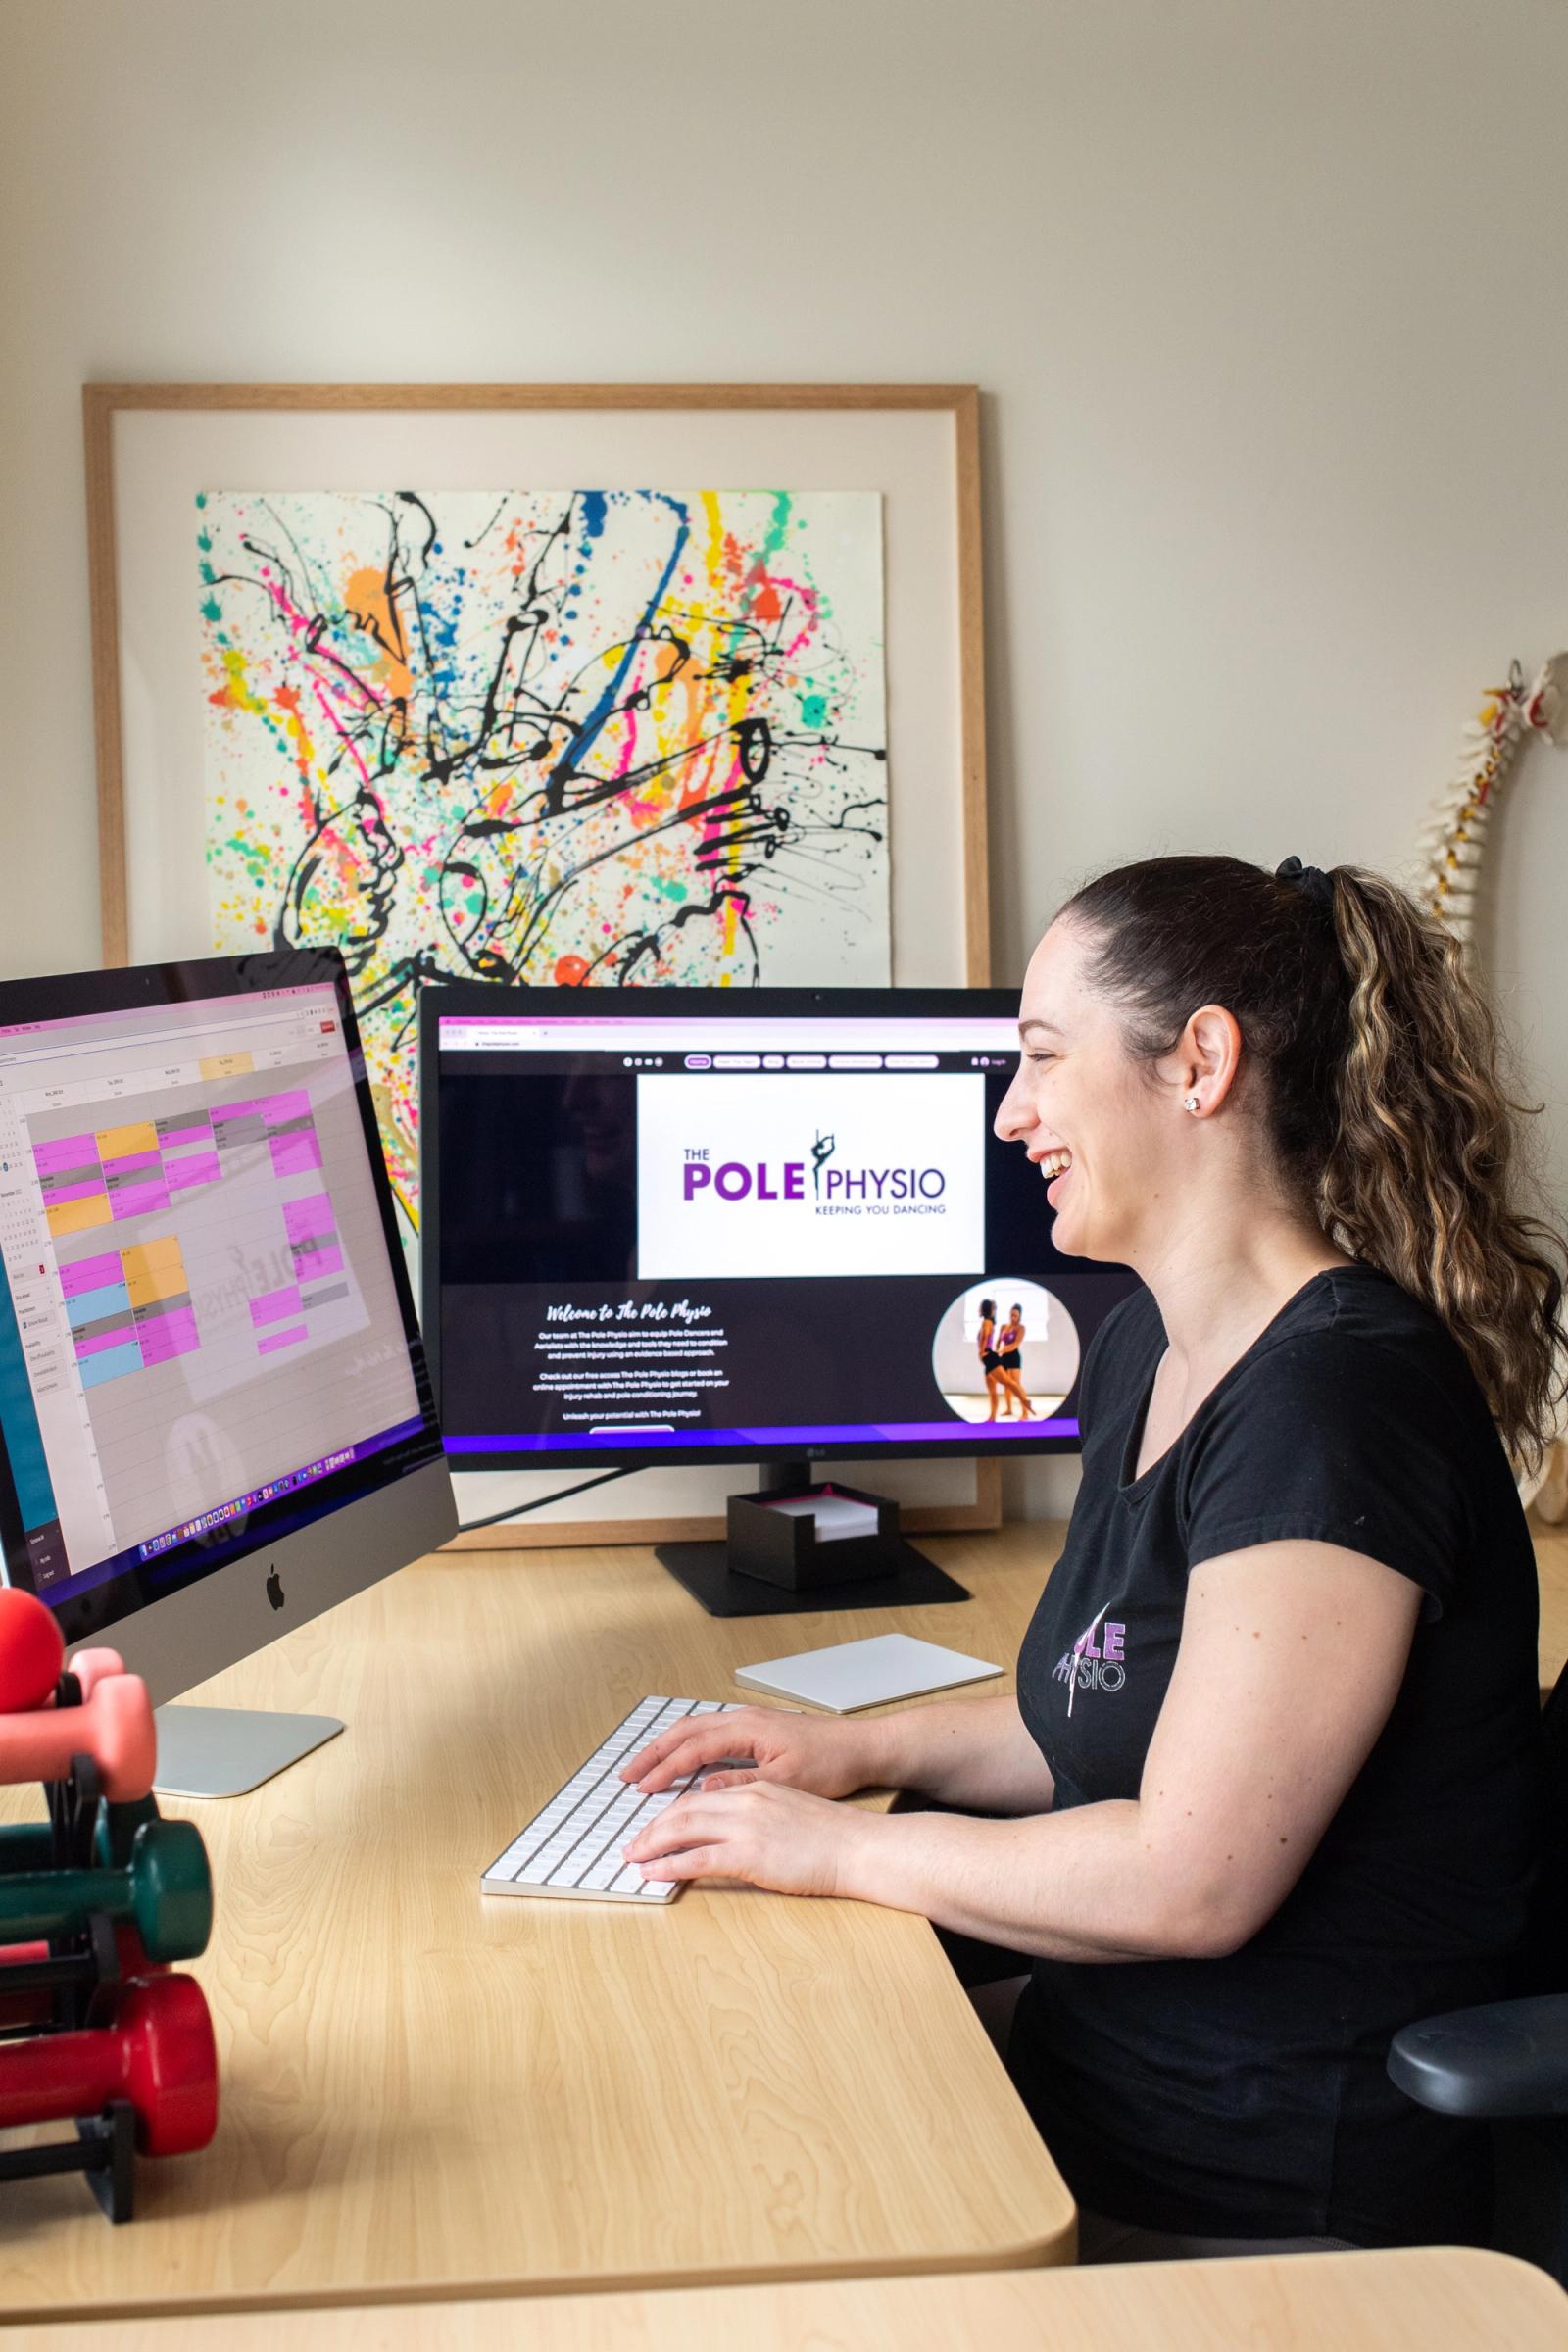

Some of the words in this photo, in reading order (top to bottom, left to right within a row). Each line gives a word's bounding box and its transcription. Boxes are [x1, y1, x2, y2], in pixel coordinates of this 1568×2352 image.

[684, 1149, 710, 1160] THE
[684, 1162, 805, 1200] POLE
[827, 1168, 946, 1199] PHYSIO
[815, 1206, 862, 1215] KEEPING
[866, 1205, 889, 1215] YOU
[893, 1204, 947, 1214] DANCING
[547, 1304, 597, 1322] Welcome
[599, 1304, 613, 1322] to
[615, 1300, 638, 1320] The
[640, 1302, 668, 1320] Pole
[670, 1299, 712, 1324] Physio
[607, 1331, 628, 1340] Physio
[592, 1341, 627, 1349] knowledge
[658, 1340, 672, 1348] they
[587, 1351, 606, 1360] injury
[649, 1370, 670, 1379] Physio
[670, 1370, 689, 1379] blogs
[554, 1382, 597, 1391] appointment
[564, 1393, 583, 1401] injury
[631, 1390, 672, 1398] conditioning
[590, 1412, 605, 1421] your
[605, 1411, 635, 1420] potential
